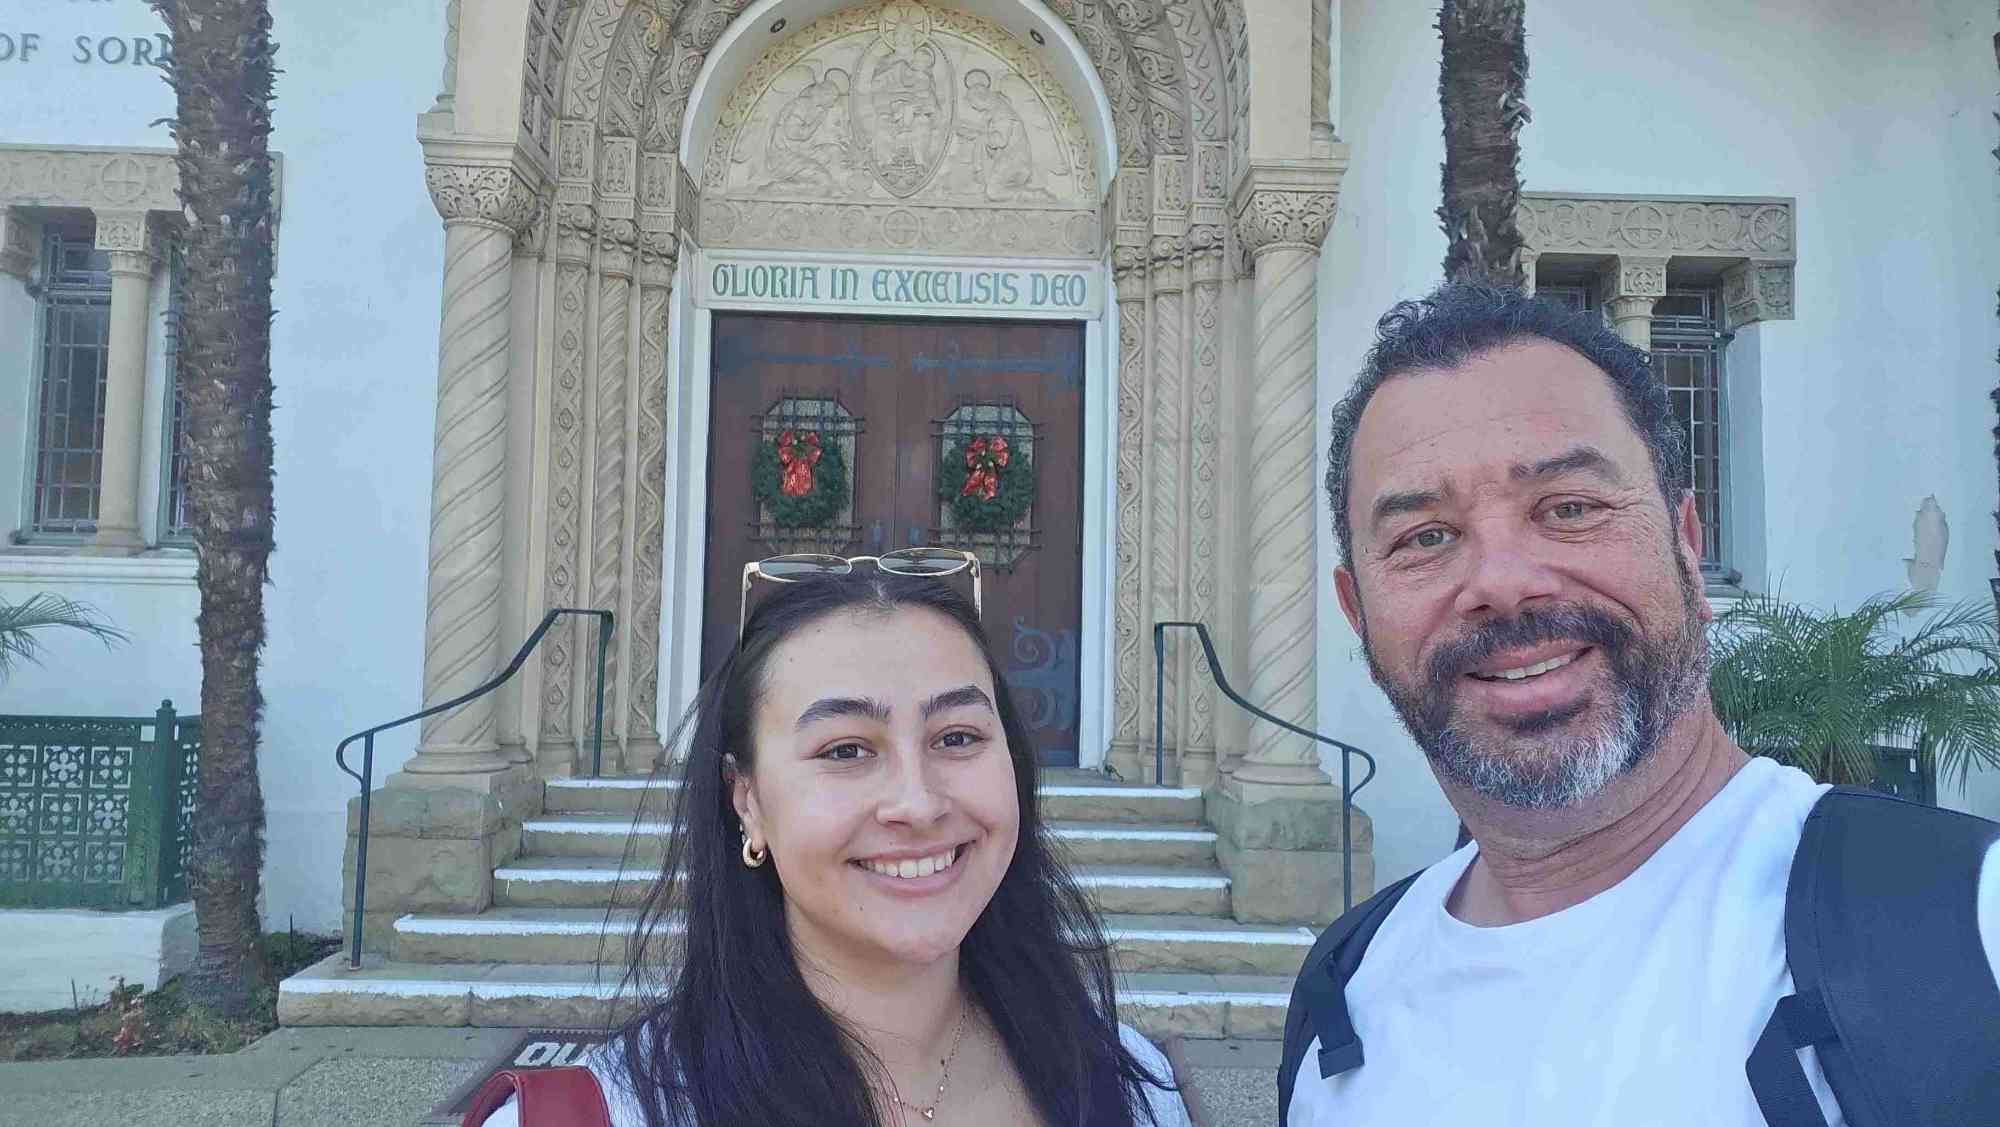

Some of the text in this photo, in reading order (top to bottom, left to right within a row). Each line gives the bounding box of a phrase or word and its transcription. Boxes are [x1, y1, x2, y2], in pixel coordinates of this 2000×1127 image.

[712, 263, 1086, 306] GLORIA IN EXCELSIS DEO
